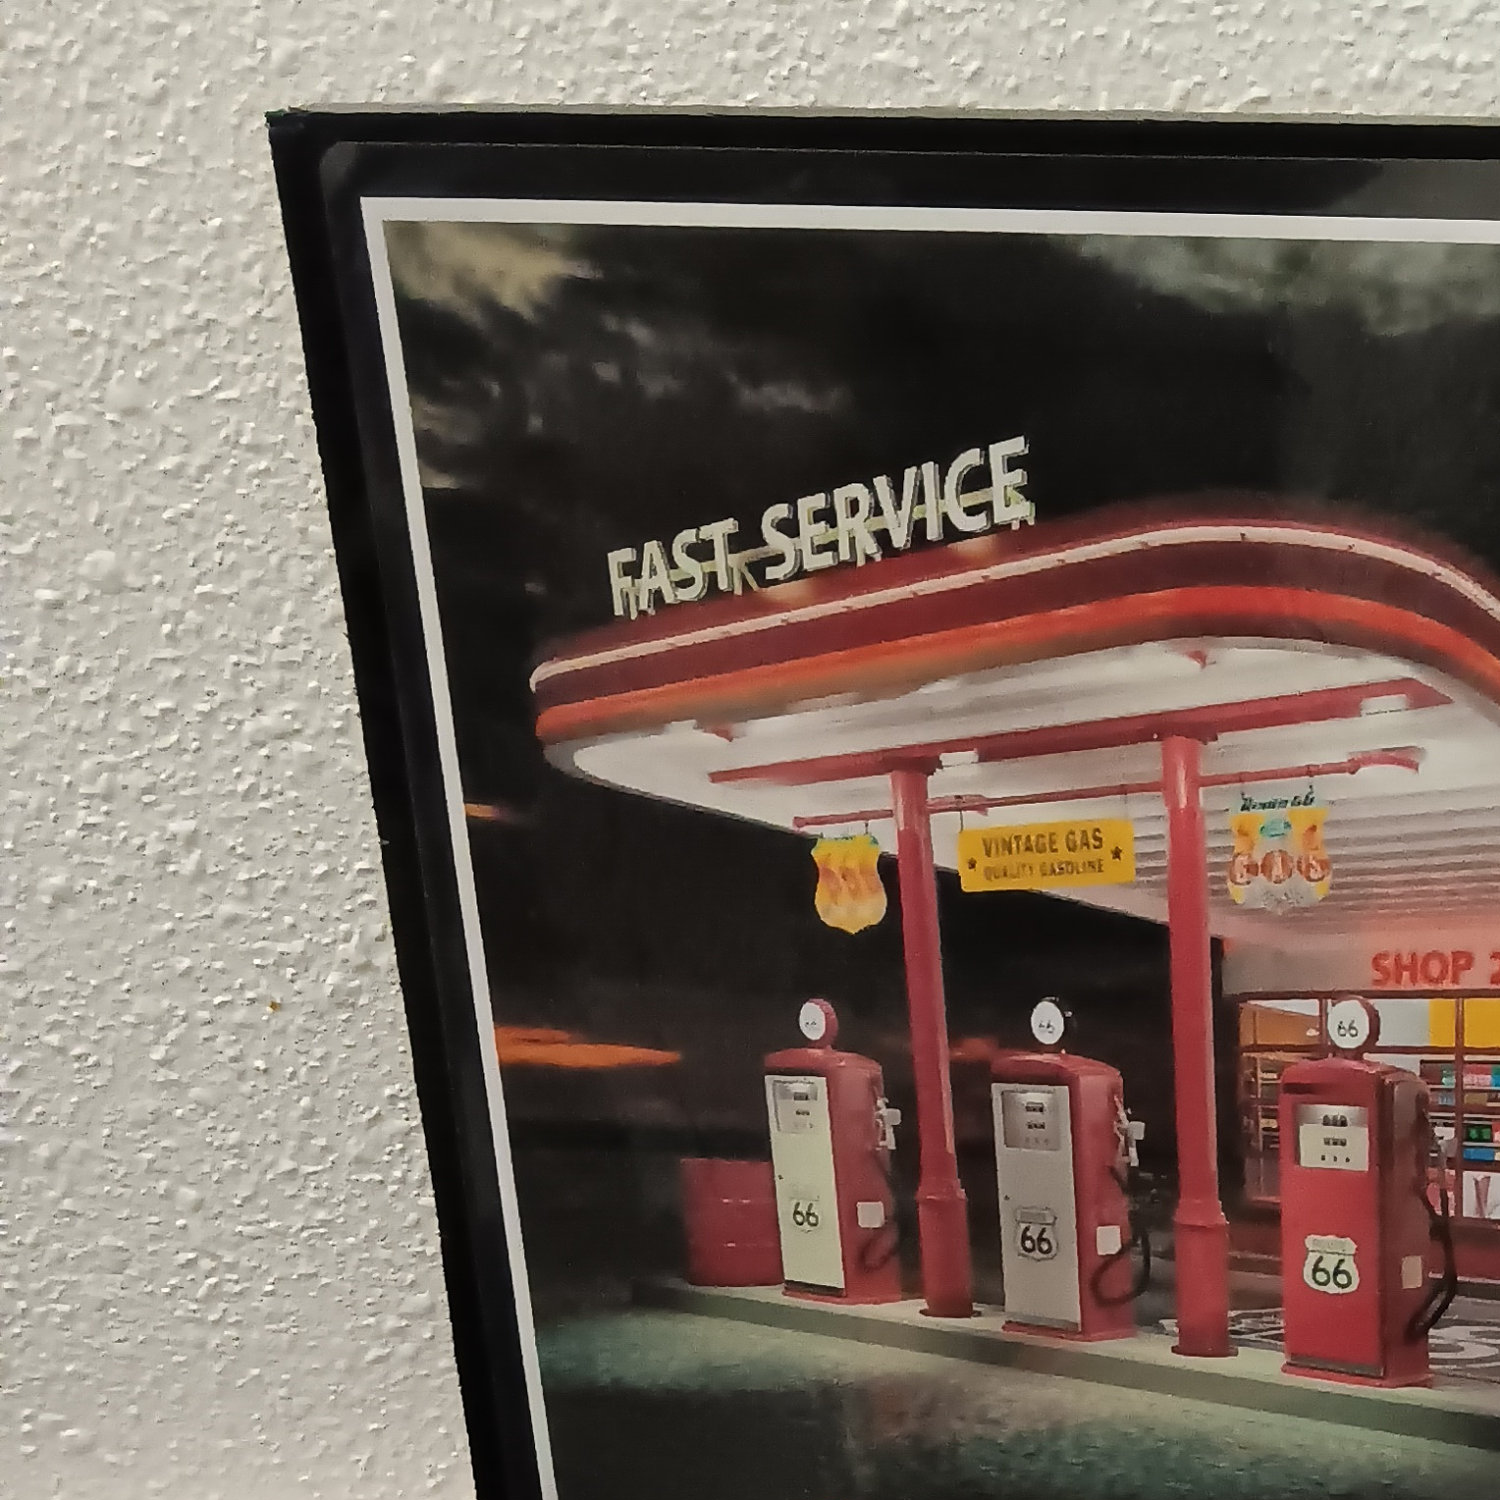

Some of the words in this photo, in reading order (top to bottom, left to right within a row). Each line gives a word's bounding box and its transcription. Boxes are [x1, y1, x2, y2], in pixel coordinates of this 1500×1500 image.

[606, 517, 739, 619] FAST
[761, 436, 1034, 581] SERVICE
[982, 832, 1060, 858] VINTAGE
[1065, 827, 1104, 853] GAS
[1371, 950, 1475, 988] SHOP
[1337, 1019, 1359, 1038] 66
[792, 1202, 820, 1228] 66
[1020, 1225, 1053, 1255] 66
[1311, 1255, 1353, 1290] 66
